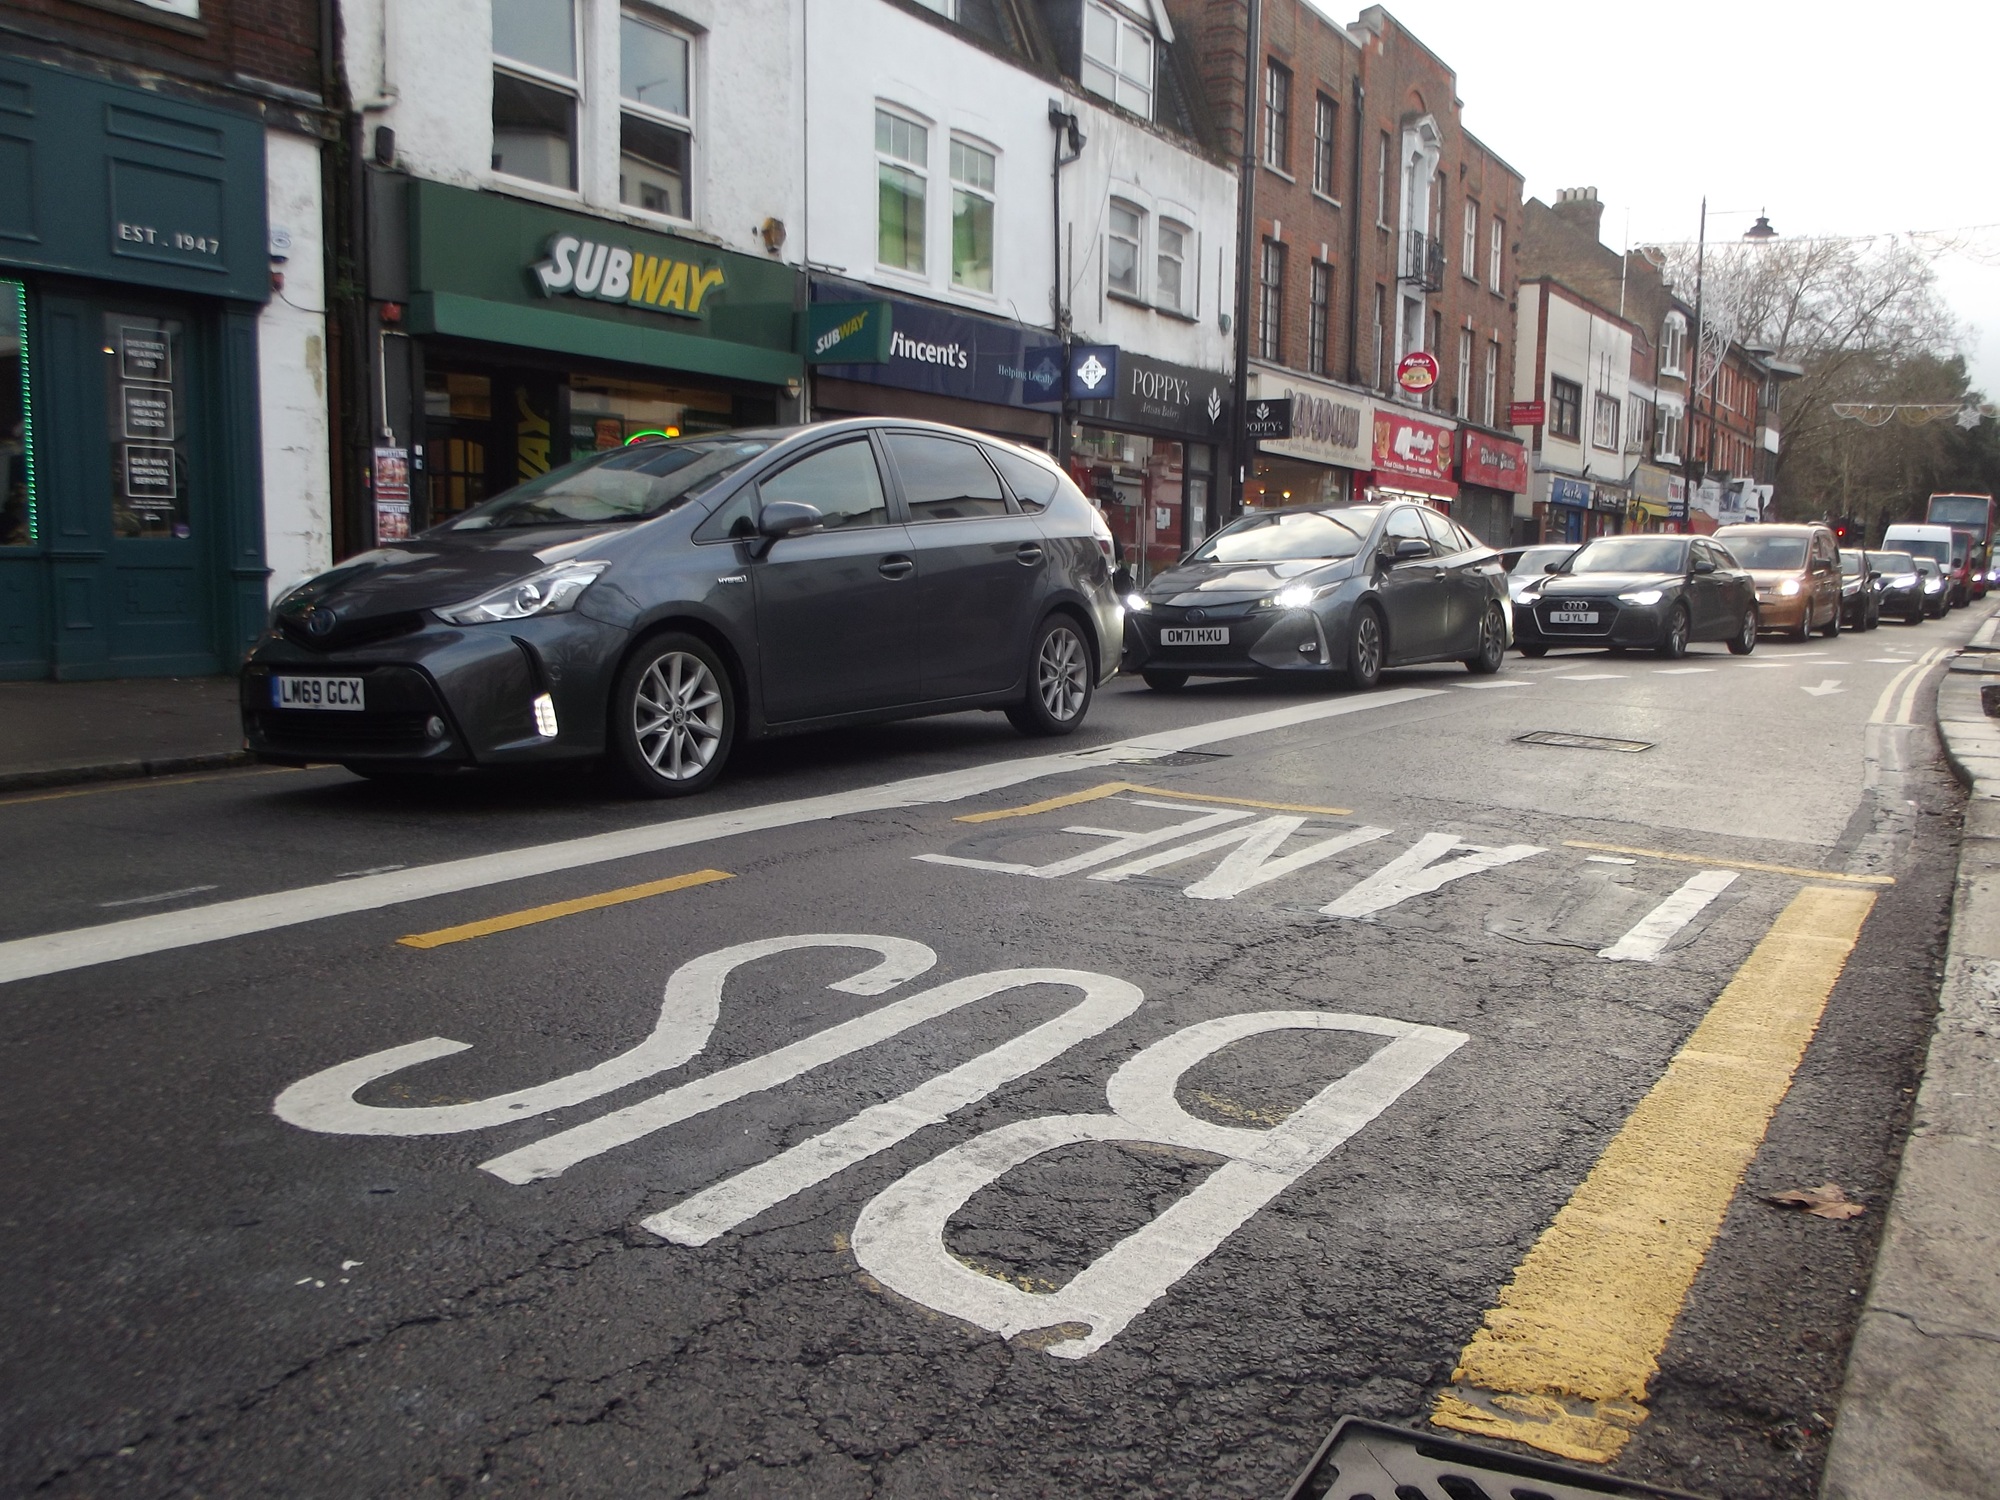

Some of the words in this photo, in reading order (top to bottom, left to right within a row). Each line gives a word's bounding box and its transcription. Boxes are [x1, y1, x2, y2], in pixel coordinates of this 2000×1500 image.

[175, 233, 220, 255] 1947
[540, 236, 725, 313] SUBWAY
[815, 310, 868, 355] SUBWAY
[126, 340, 165, 351] DISCREET
[127, 349, 164, 360] HEARING
[138, 360, 157, 369] AIDS
[998, 364, 1027, 382] Helping
[1028, 371, 1054, 386] Locally
[1132, 368, 1190, 407] POPPY's
[128, 399, 166, 409] HEARING
[132, 408, 164, 418] HEALTH
[132, 418, 165, 428] CHECKS
[131, 466, 170, 477] REMOVAL
[134, 476, 168, 486] SERVICE
[1559, 613, 1570, 622] L3
[1572, 613, 1588, 622] YLT
[1197, 629, 1222, 642] HXU
[326, 680, 361, 705] GCX
[913, 799, 1740, 963] LANE
[273, 934, 1470, 1360] BUS
